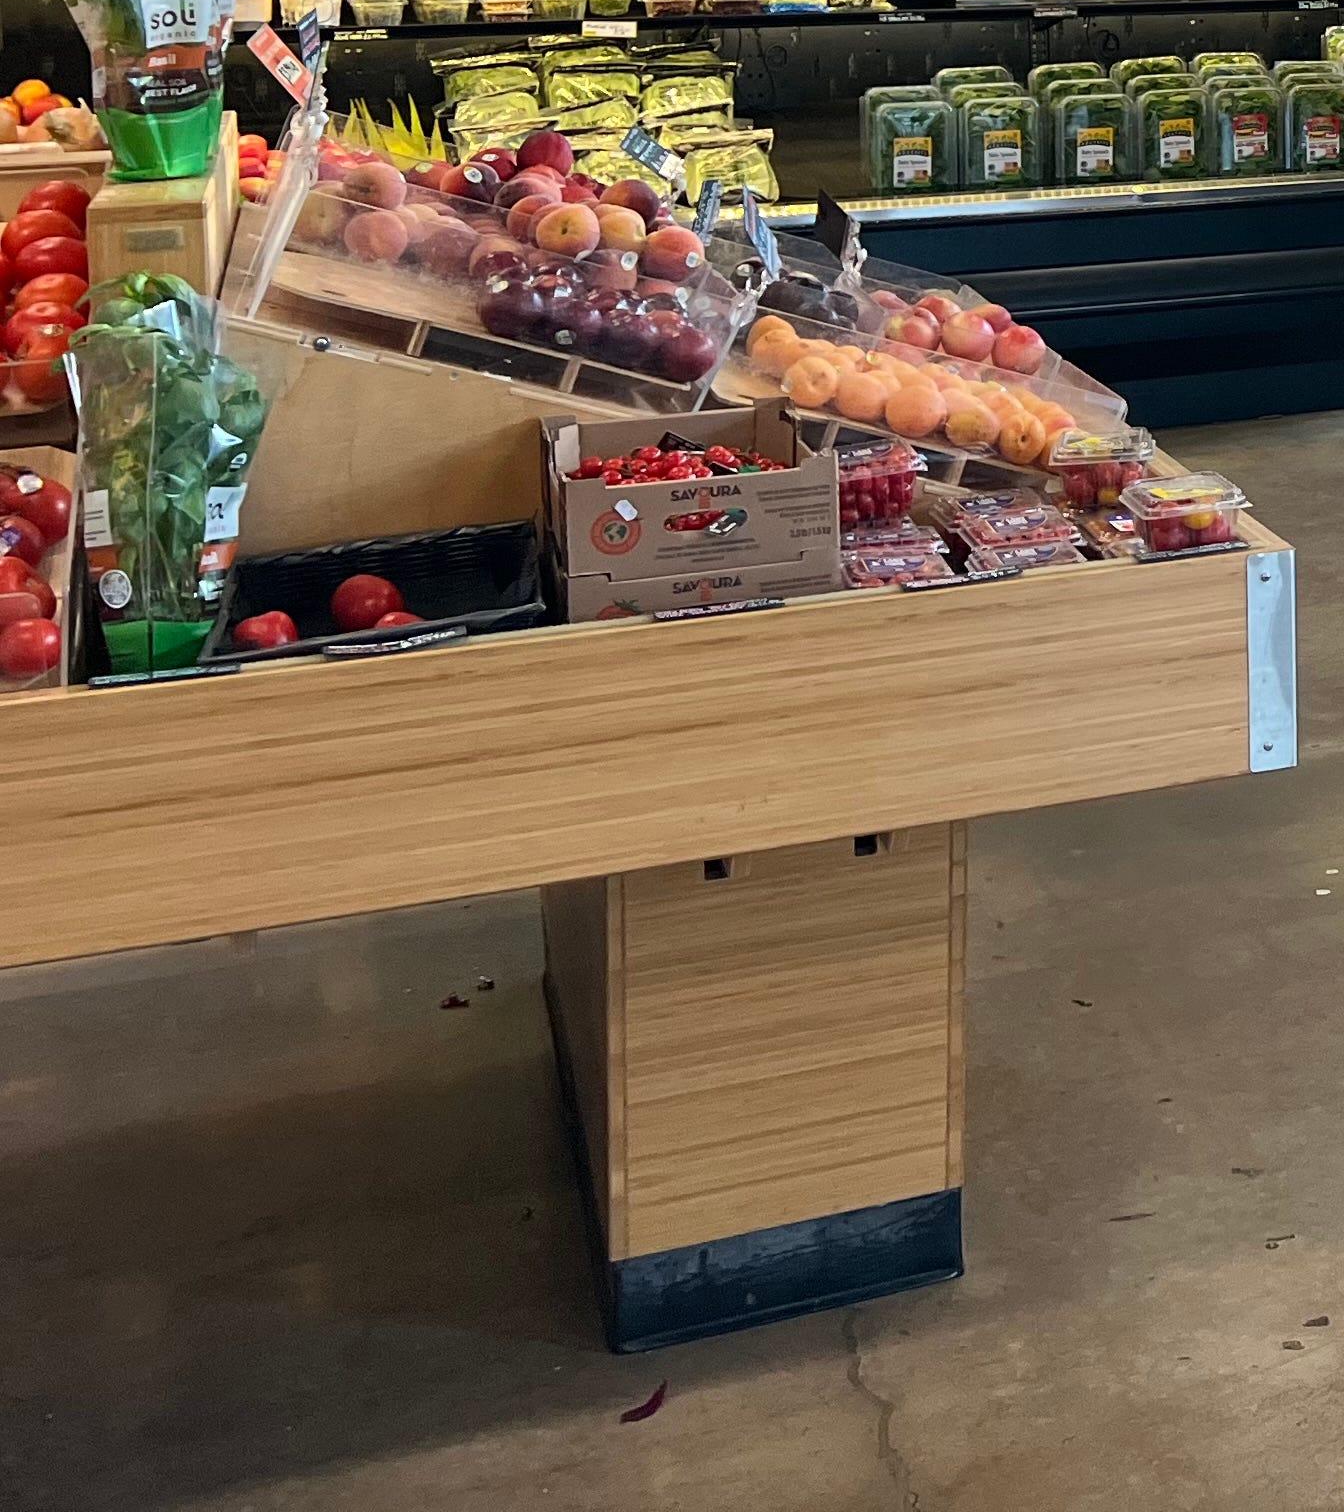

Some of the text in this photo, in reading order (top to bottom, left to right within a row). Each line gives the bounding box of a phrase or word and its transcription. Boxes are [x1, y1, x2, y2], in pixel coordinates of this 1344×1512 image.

[150, 0, 197, 30] soli
[670, 485, 742, 502] SAVOURA
[672, 574, 743, 595] SAVOURA
